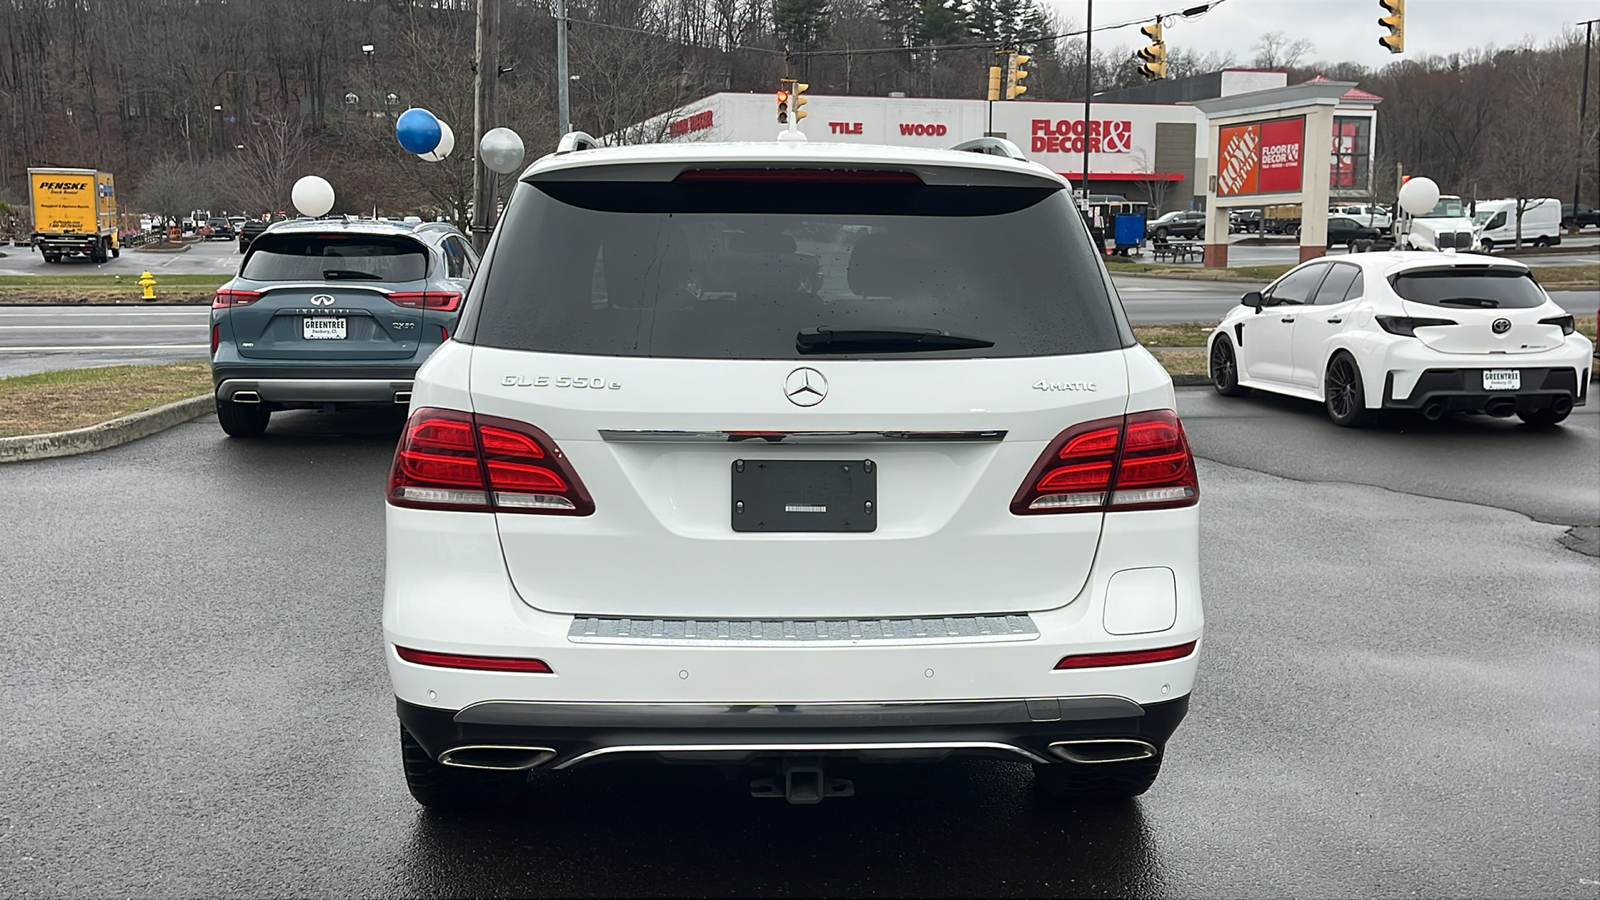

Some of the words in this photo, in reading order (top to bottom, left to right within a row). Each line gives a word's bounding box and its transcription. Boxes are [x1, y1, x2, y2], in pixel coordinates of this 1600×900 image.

[828, 121, 863, 135] TILE
[899, 123, 947, 137] WOOD
[1031, 119, 1102, 137] FLOOR
[1031, 136, 1102, 153] DECOR
[1223, 132, 1242, 160] THE
[1262, 145, 1287, 155] FLOOR
[1218, 126, 1259, 195] HOME
[1262, 153, 1287, 164] DECOR
[1232, 148, 1258, 194] DEPOT
[39, 182, 87, 190] PENSKE
[305, 321, 344, 329] GREENTREE
[501, 375, 551, 388] GLE
[1032, 379, 1097, 393] 4MATIC
